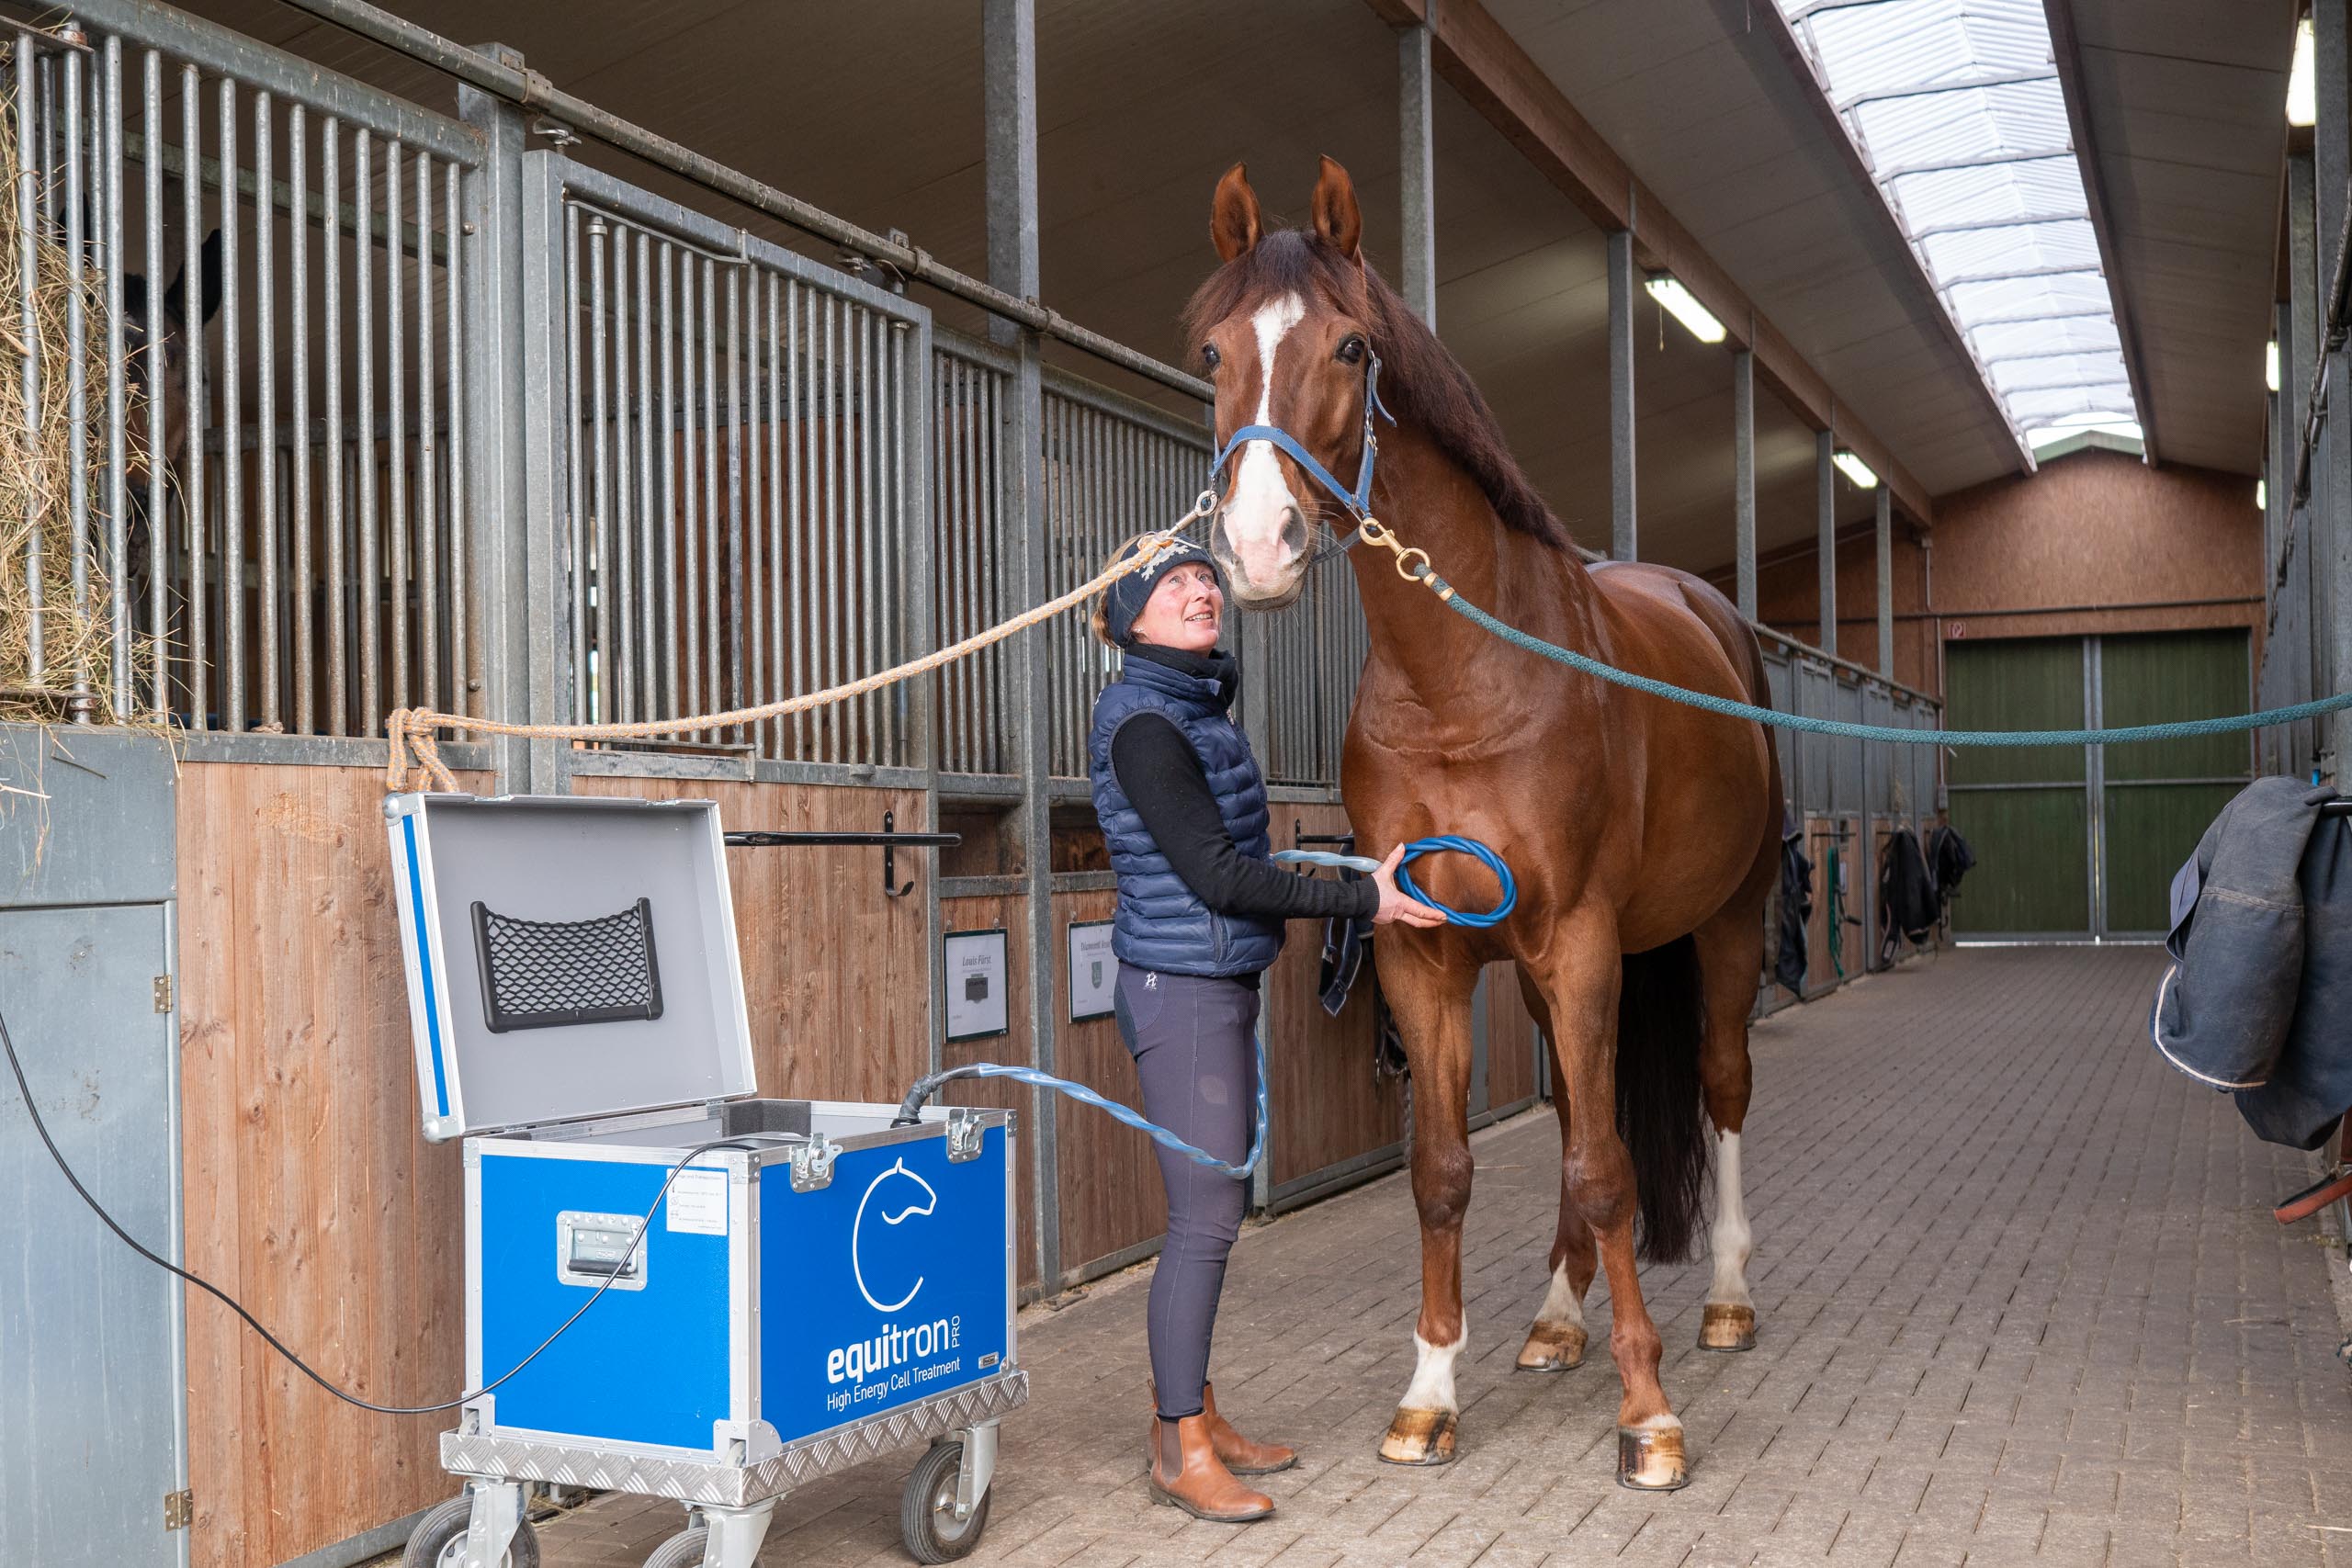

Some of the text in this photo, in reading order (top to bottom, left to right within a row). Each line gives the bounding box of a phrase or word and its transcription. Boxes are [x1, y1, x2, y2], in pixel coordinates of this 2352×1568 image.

[962, 955, 978, 966] Louis
[827, 1318, 949, 1384] equitron
[951, 1315, 960, 1348] PRO
[827, 1357, 961, 1412] High Energy Cell Treatment
